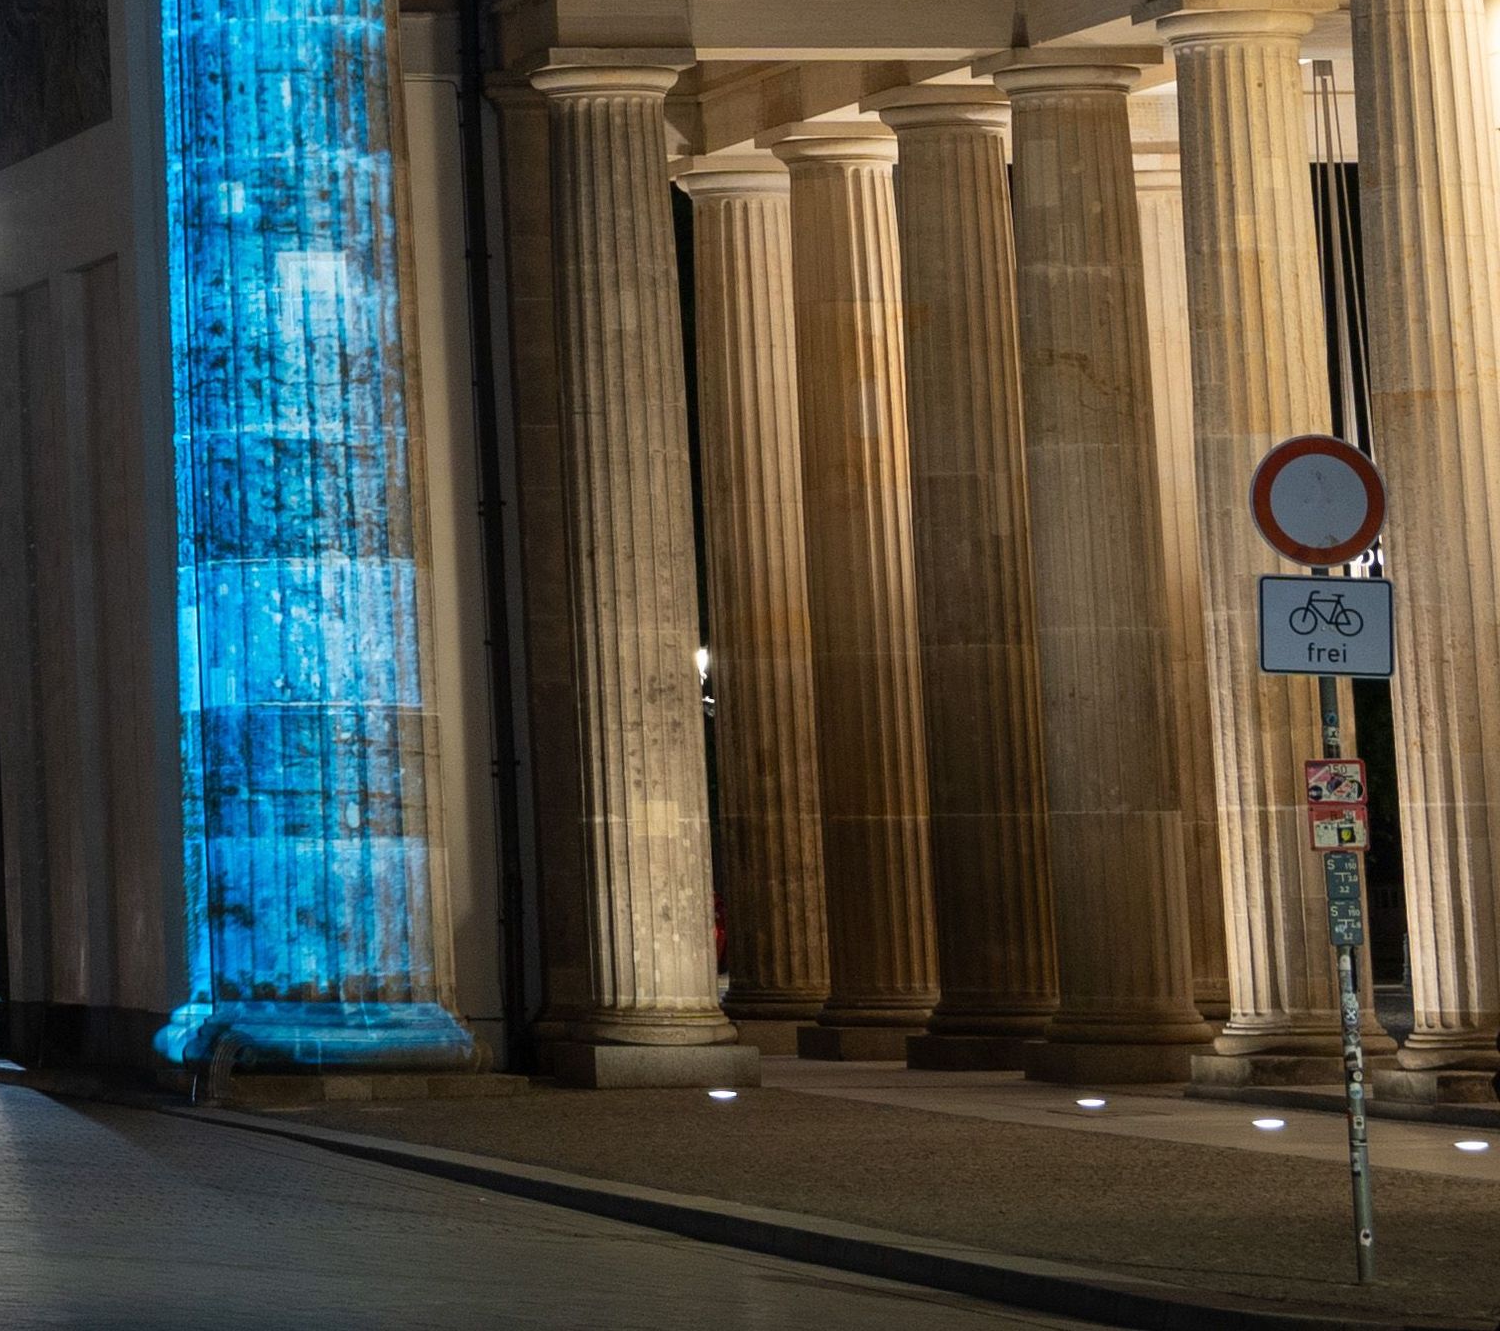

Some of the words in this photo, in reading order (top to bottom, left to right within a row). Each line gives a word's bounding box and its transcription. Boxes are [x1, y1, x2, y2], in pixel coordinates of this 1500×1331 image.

[1307, 642, 1348, 663] frei
[1327, 859, 1336, 870] S
[1330, 906, 1339, 917] S
